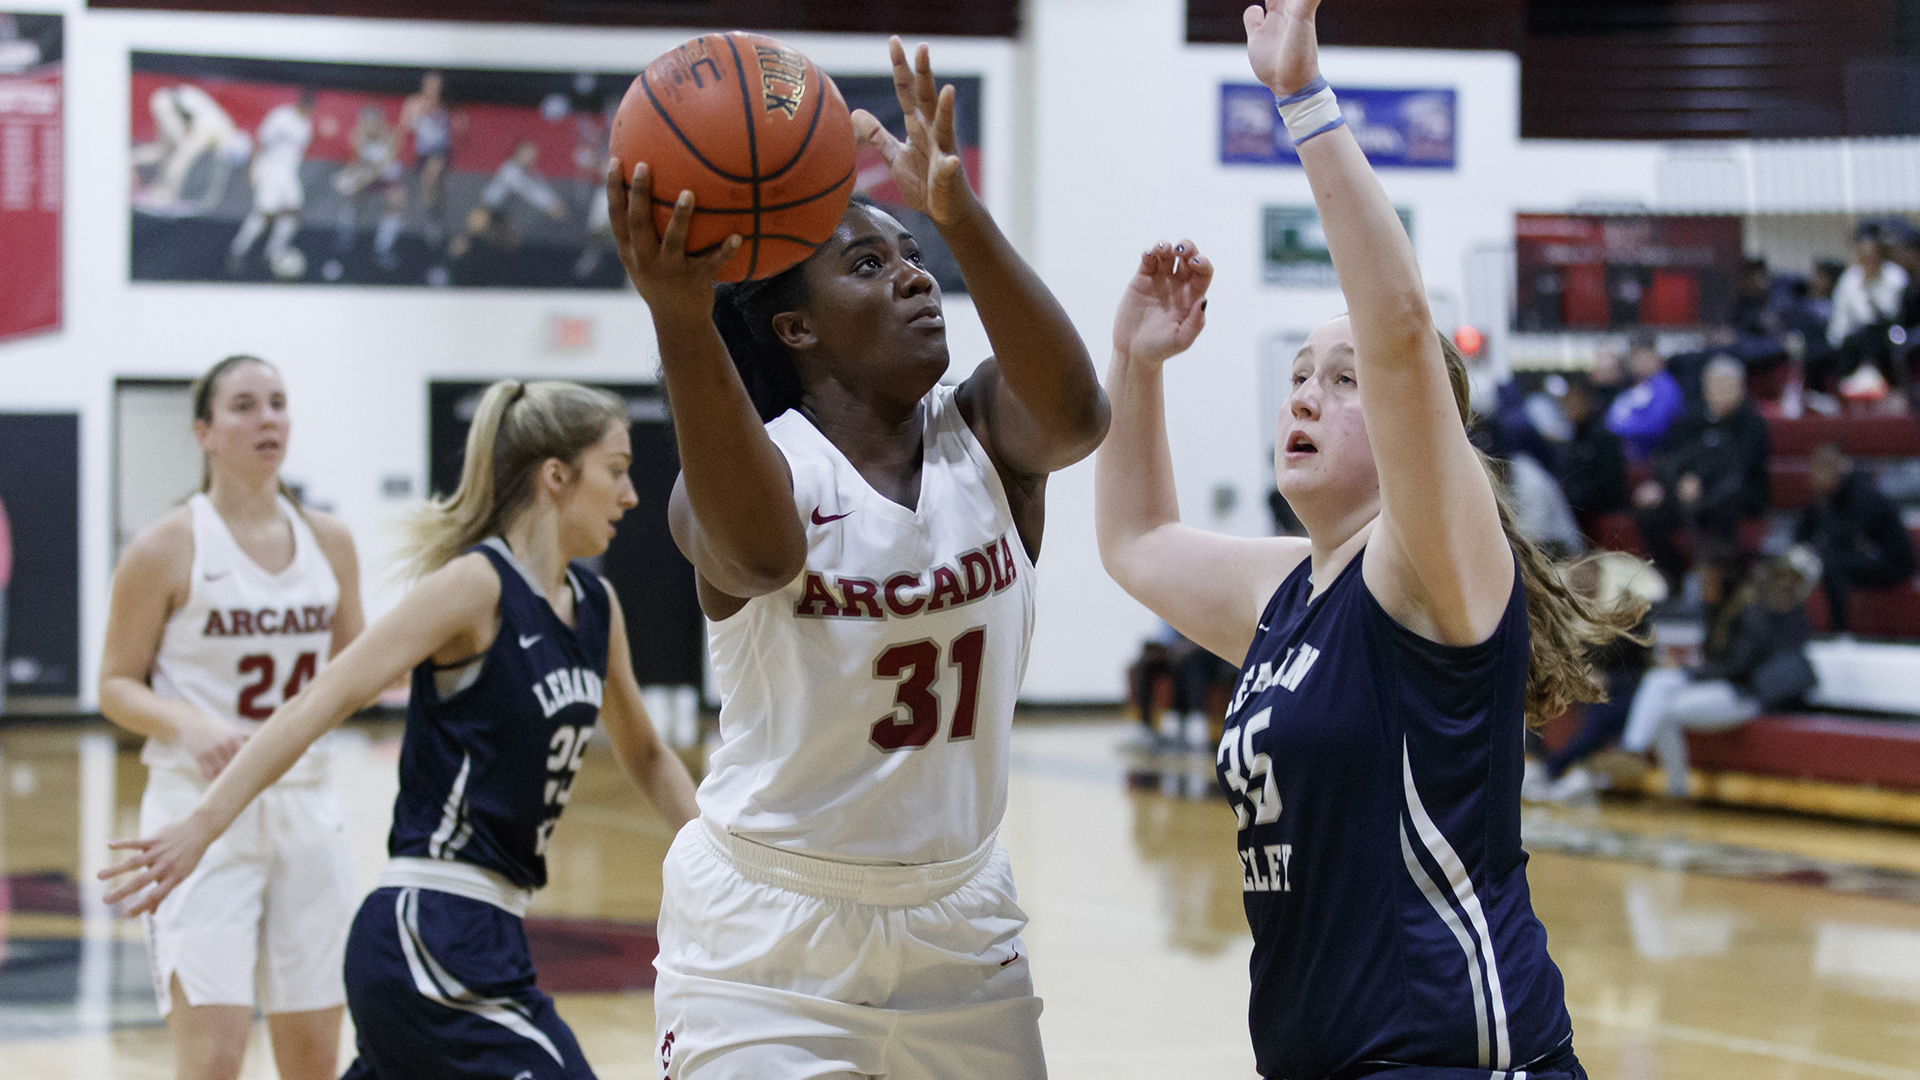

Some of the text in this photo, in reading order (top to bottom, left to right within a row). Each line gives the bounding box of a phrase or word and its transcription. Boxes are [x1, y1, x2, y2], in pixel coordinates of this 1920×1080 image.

[794, 533, 1018, 621] ARCADIA
[868, 624, 987, 754] 31
[1217, 705, 1283, 831] 35
